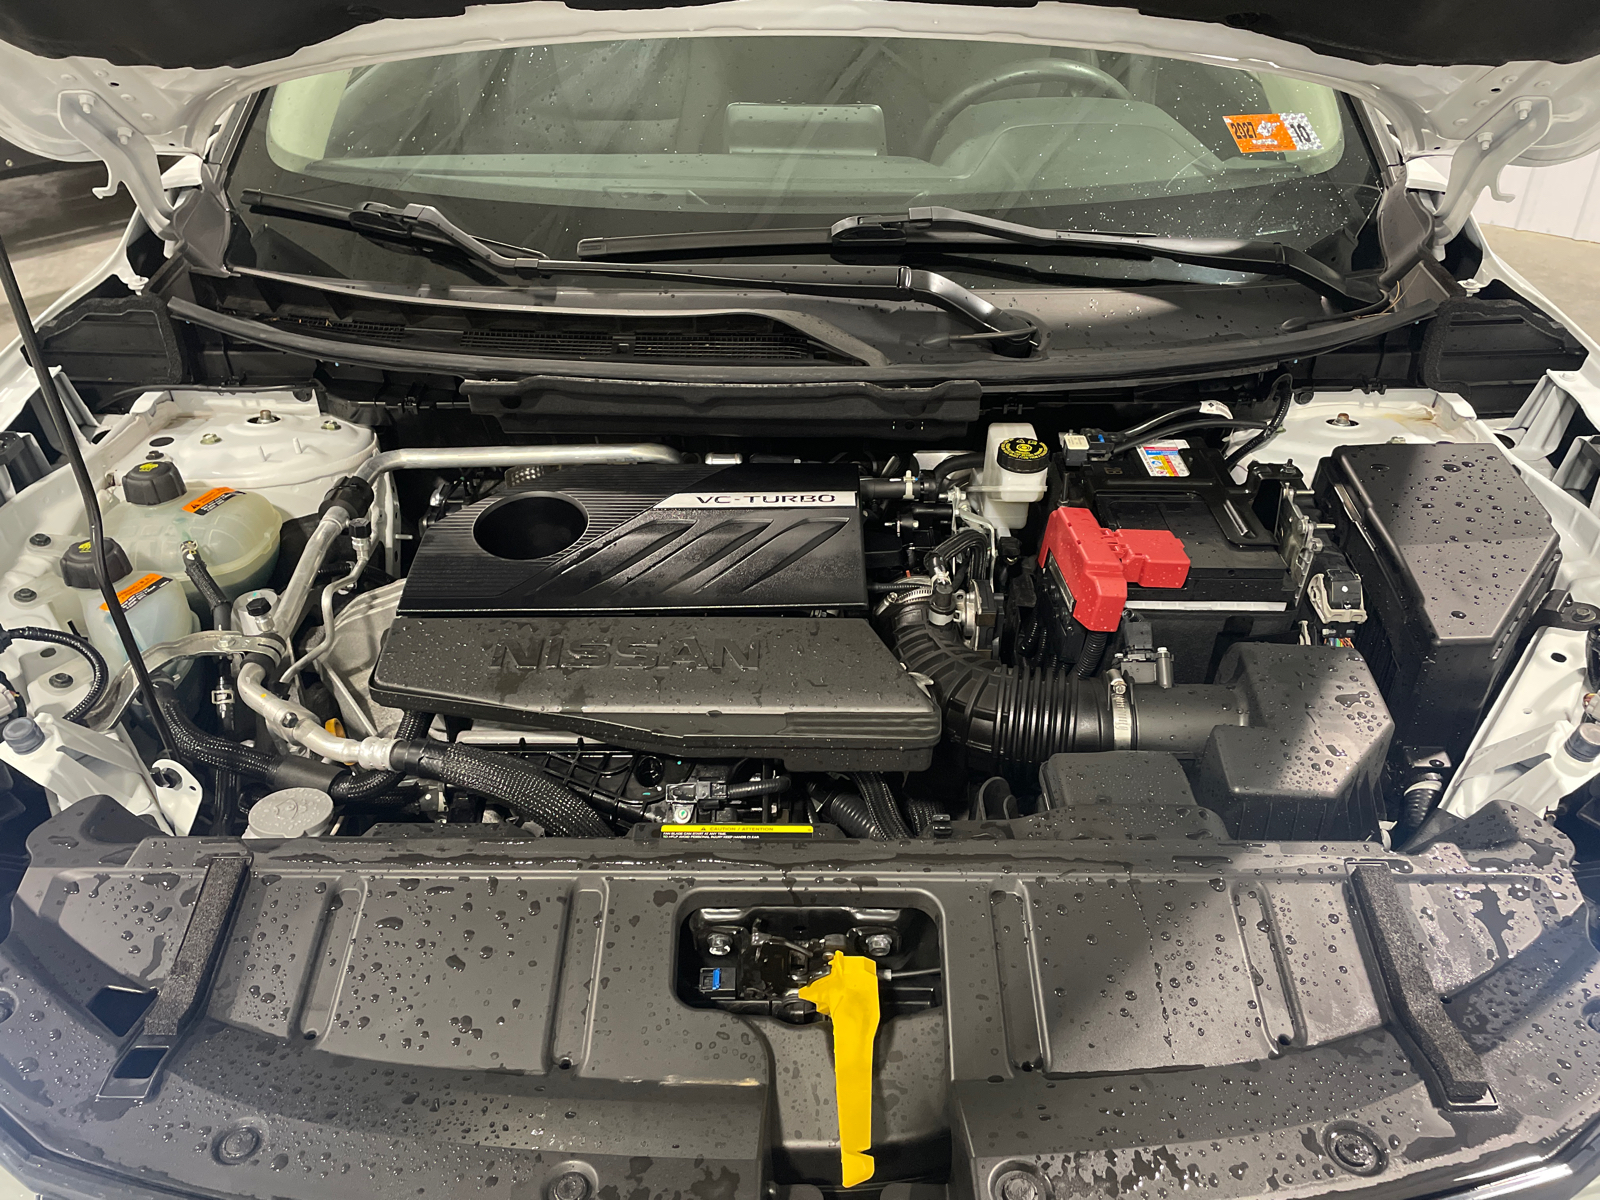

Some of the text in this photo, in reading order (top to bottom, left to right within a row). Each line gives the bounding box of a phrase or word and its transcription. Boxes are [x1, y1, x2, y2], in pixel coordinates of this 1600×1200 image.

[1230, 121, 1258, 140] 2027
[1289, 123, 1312, 143] 10
[696, 494, 836, 504] VC-TURBO
[488, 636, 760, 670] NISSAN
